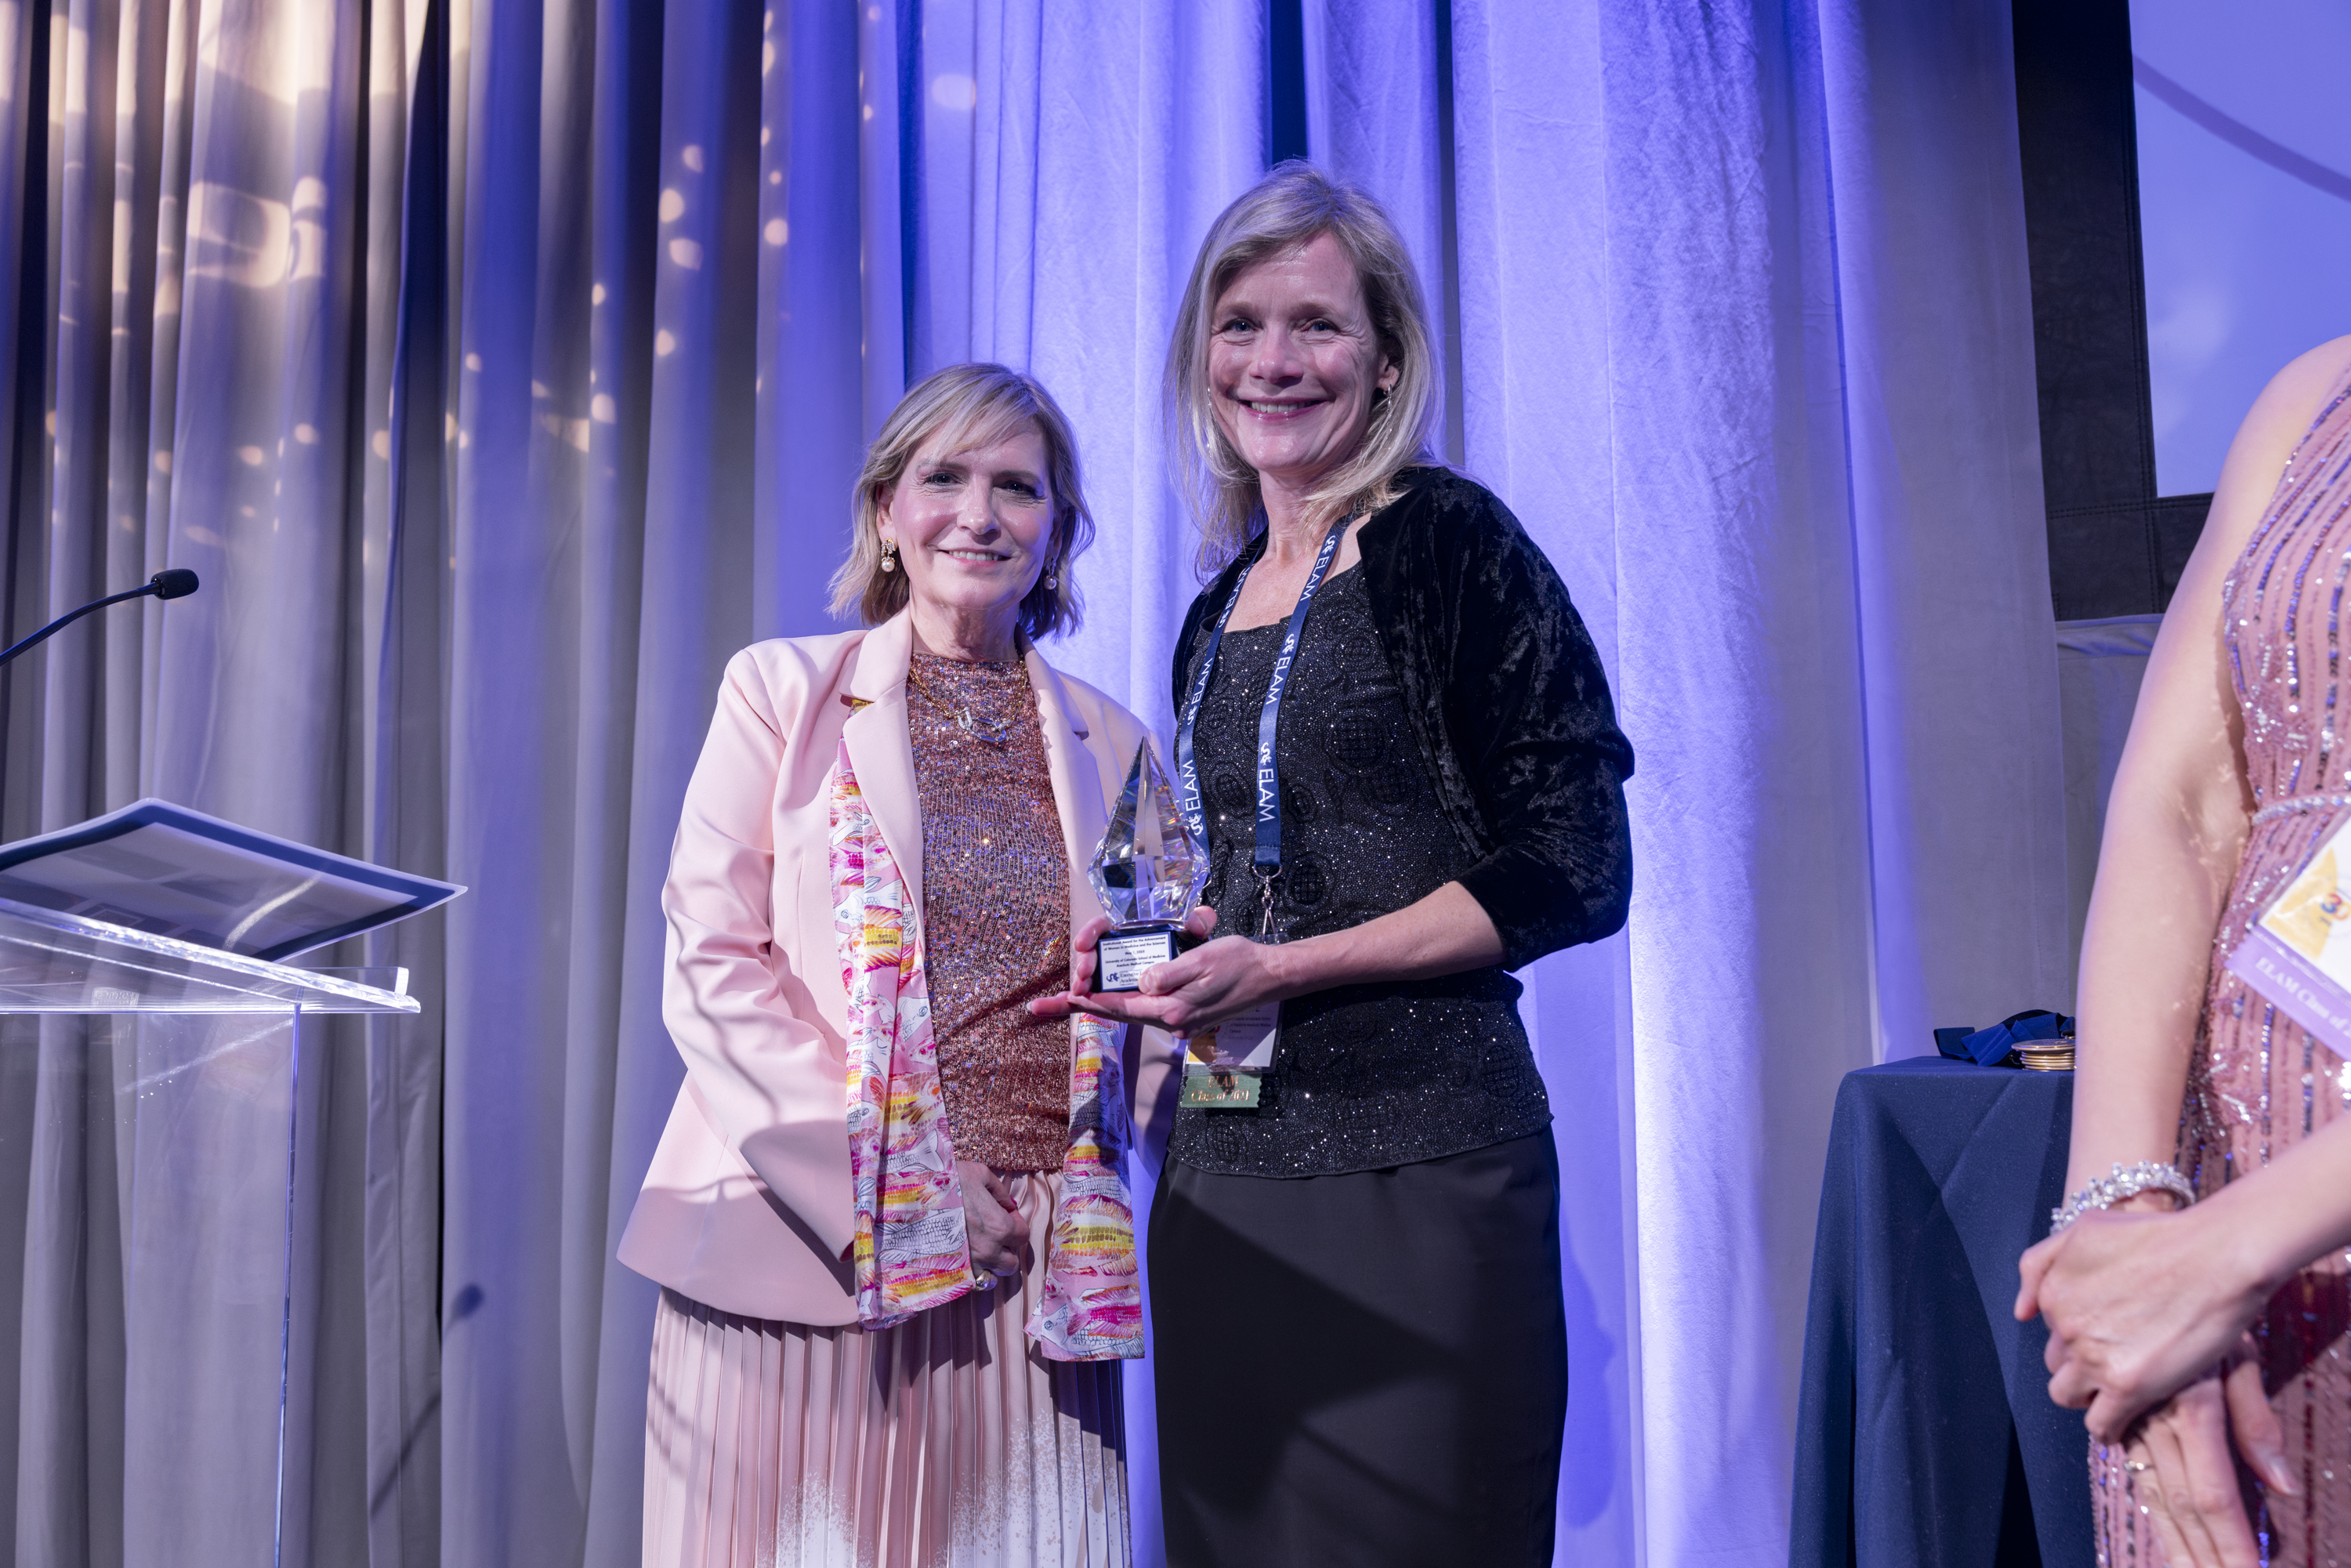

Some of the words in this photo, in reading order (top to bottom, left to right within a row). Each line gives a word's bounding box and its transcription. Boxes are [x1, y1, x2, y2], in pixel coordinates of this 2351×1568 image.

[1225, 567, 1251, 610] ELAM
[1300, 556, 1329, 602] ELAM
[1190, 657, 1213, 704] ELAM
[1266, 656, 1291, 705] ELAM
[1182, 759, 1201, 812] ELAM
[1259, 768, 1276, 822] ELAM
[2255, 956, 2300, 994] ELAM
[1191, 1089, 1215, 1102] Class
[1216, 1089, 1229, 1101] of
[1229, 1088, 1250, 1101] 2021
[1208, 1074, 1239, 1088] ELAM
